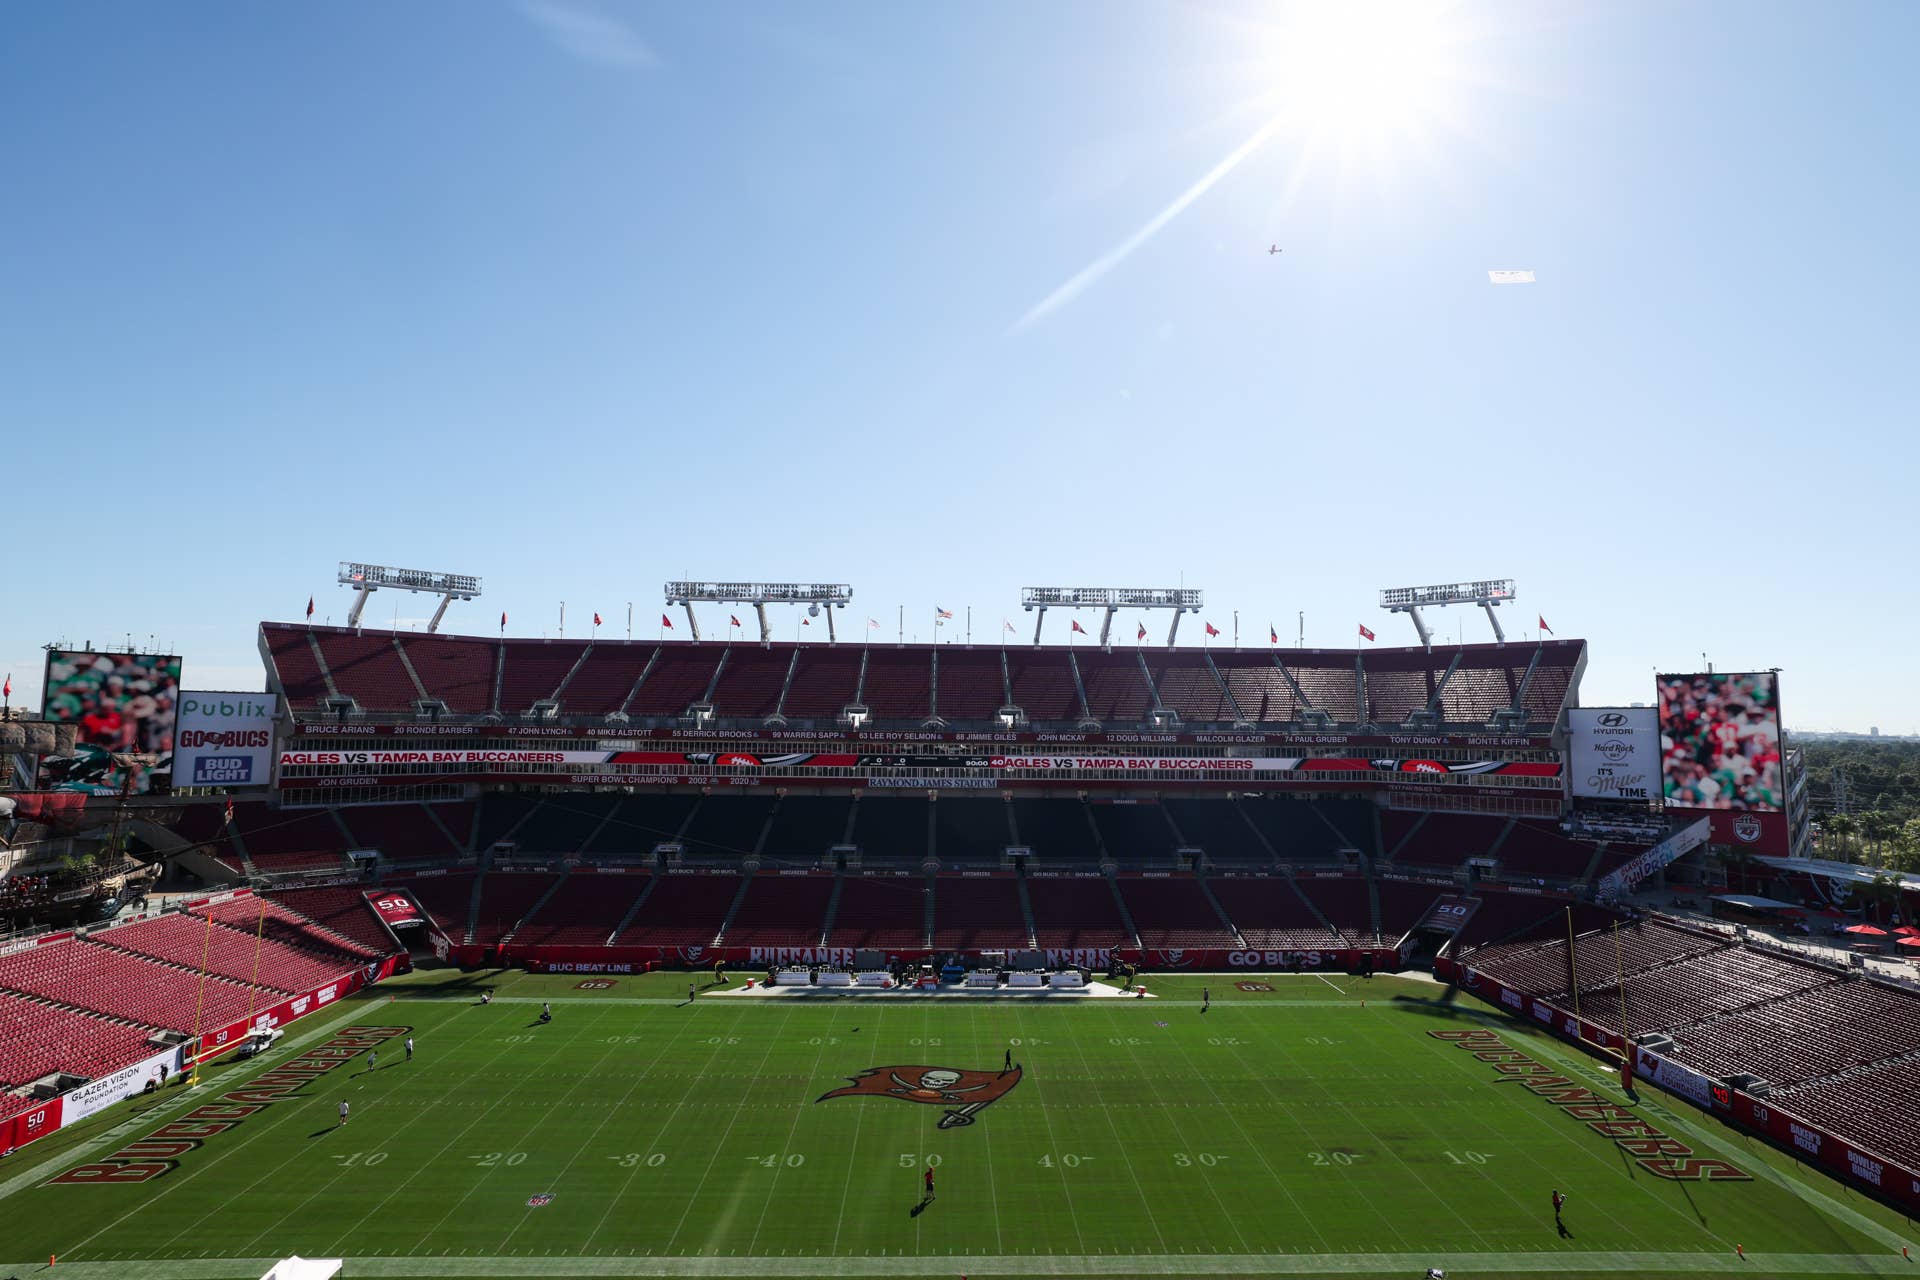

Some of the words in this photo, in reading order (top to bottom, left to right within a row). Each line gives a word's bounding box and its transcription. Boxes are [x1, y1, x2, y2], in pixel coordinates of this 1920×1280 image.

[182, 699, 265, 717] Publix
[305, 725, 339, 734] BRUCE
[340, 725, 376, 734] ARIANS
[393, 726, 405, 734] 20
[438, 726, 474, 735] BARBER
[508, 727, 518, 735] 47
[518, 727, 541, 735] JOHN
[587, 728, 597, 736] 40
[597, 728, 616, 736] MIKE
[617, 729, 652, 737] ALSTOTT
[782, 731, 817, 739] WARREN
[869, 732, 885, 740] LEE
[886, 732, 903, 740] ROY
[904, 732, 937, 740] SELMON
[180, 730, 206, 747] GO
[224, 730, 269, 747] BUCS
[1036, 734, 1058, 742] JOHN
[1196, 735, 1234, 743] MALCOLM
[1235, 735, 1266, 743] GLAZER
[1315, 736, 1348, 744] GRUBER
[1390, 736, 1411, 744] TONY
[1467, 737, 1499, 745] MONTE
[1500, 738, 1530, 746] KIFFIN
[1593, 743, 1615, 752] Hard
[1615, 744, 1635, 754] Rock
[205, 758, 242, 769] BUD
[279, 753, 340, 764] AGLES
[344, 753, 368, 763] VS
[373, 752, 428, 763] TAMPA
[432, 752, 463, 762] BAY
[466, 752, 565, 762] BUCCANEERS
[991, 758, 1004, 766] 40
[1003, 758, 1050, 768] AGLES
[1054, 759, 1073, 768] VS
[1076, 759, 1125, 769] TAMPA
[1128, 759, 1156, 769] BAY
[1159, 759, 1254, 769] BUCCANEERS
[196, 769, 249, 781] LIGHT
[1597, 767, 1614, 776] IT'S
[318, 778, 338, 786] JON
[339, 778, 378, 786] GRUDEN
[571, 775, 600, 783] SUPER
[601, 775, 627, 784] BOWL
[628, 776, 678, 784] CHAMPIONS
[688, 777, 708, 785] 2002
[730, 777, 749, 785] 2020
[869, 779, 920, 787] RAYMOND
[921, 779, 953, 787] JAMES
[954, 779, 996, 787] STADIUM
[1587, 773, 1647, 795] Miller
[1618, 787, 1648, 798] TIME
[377, 898, 410, 910] 50
[1437, 904, 1467, 916] 50
[396, 922, 420, 930] GEICO
[750, 947, 856, 965] BUCCANEE
[1227, 950, 1263, 967] GO
[1263, 950, 1322, 966] BUCS
[549, 963, 573, 972] BUC
[575, 963, 606, 972] BEAT
[607, 964, 631, 972] LINE
[216, 1030, 228, 1044] 50
[1596, 1031, 1607, 1044] 50
[71, 1080, 108, 1102] GLAZER
[110, 1066, 141, 1085] VISION
[84, 1081, 129, 1105] FOUNDATION
[1712, 1086, 1729, 1105] 40
[36, 1025, 414, 1188] BUCCANEERS
[1426, 1029, 1753, 1182] BUCCANEERS
[27, 1110, 45, 1128] 50
[1752, 1105, 1768, 1122] 50
[1789, 1122, 1822, 1146] BAKER'S
[1794, 1135, 1818, 1156] DOZEN
[336, 1152, 389, 1167] 10
[475, 1152, 528, 1167] 20
[617, 1153, 666, 1168] 30
[759, 1154, 805, 1168] 40
[898, 1153, 943, 1168] 50
[1037, 1153, 1081, 1168] 40
[1173, 1152, 1217, 1167] 30
[1307, 1152, 1353, 1167] 20
[1443, 1151, 1488, 1165] 10
[1847, 1149, 1884, 1175] BOWLES'
[1852, 1162, 1881, 1186] BUNCH
